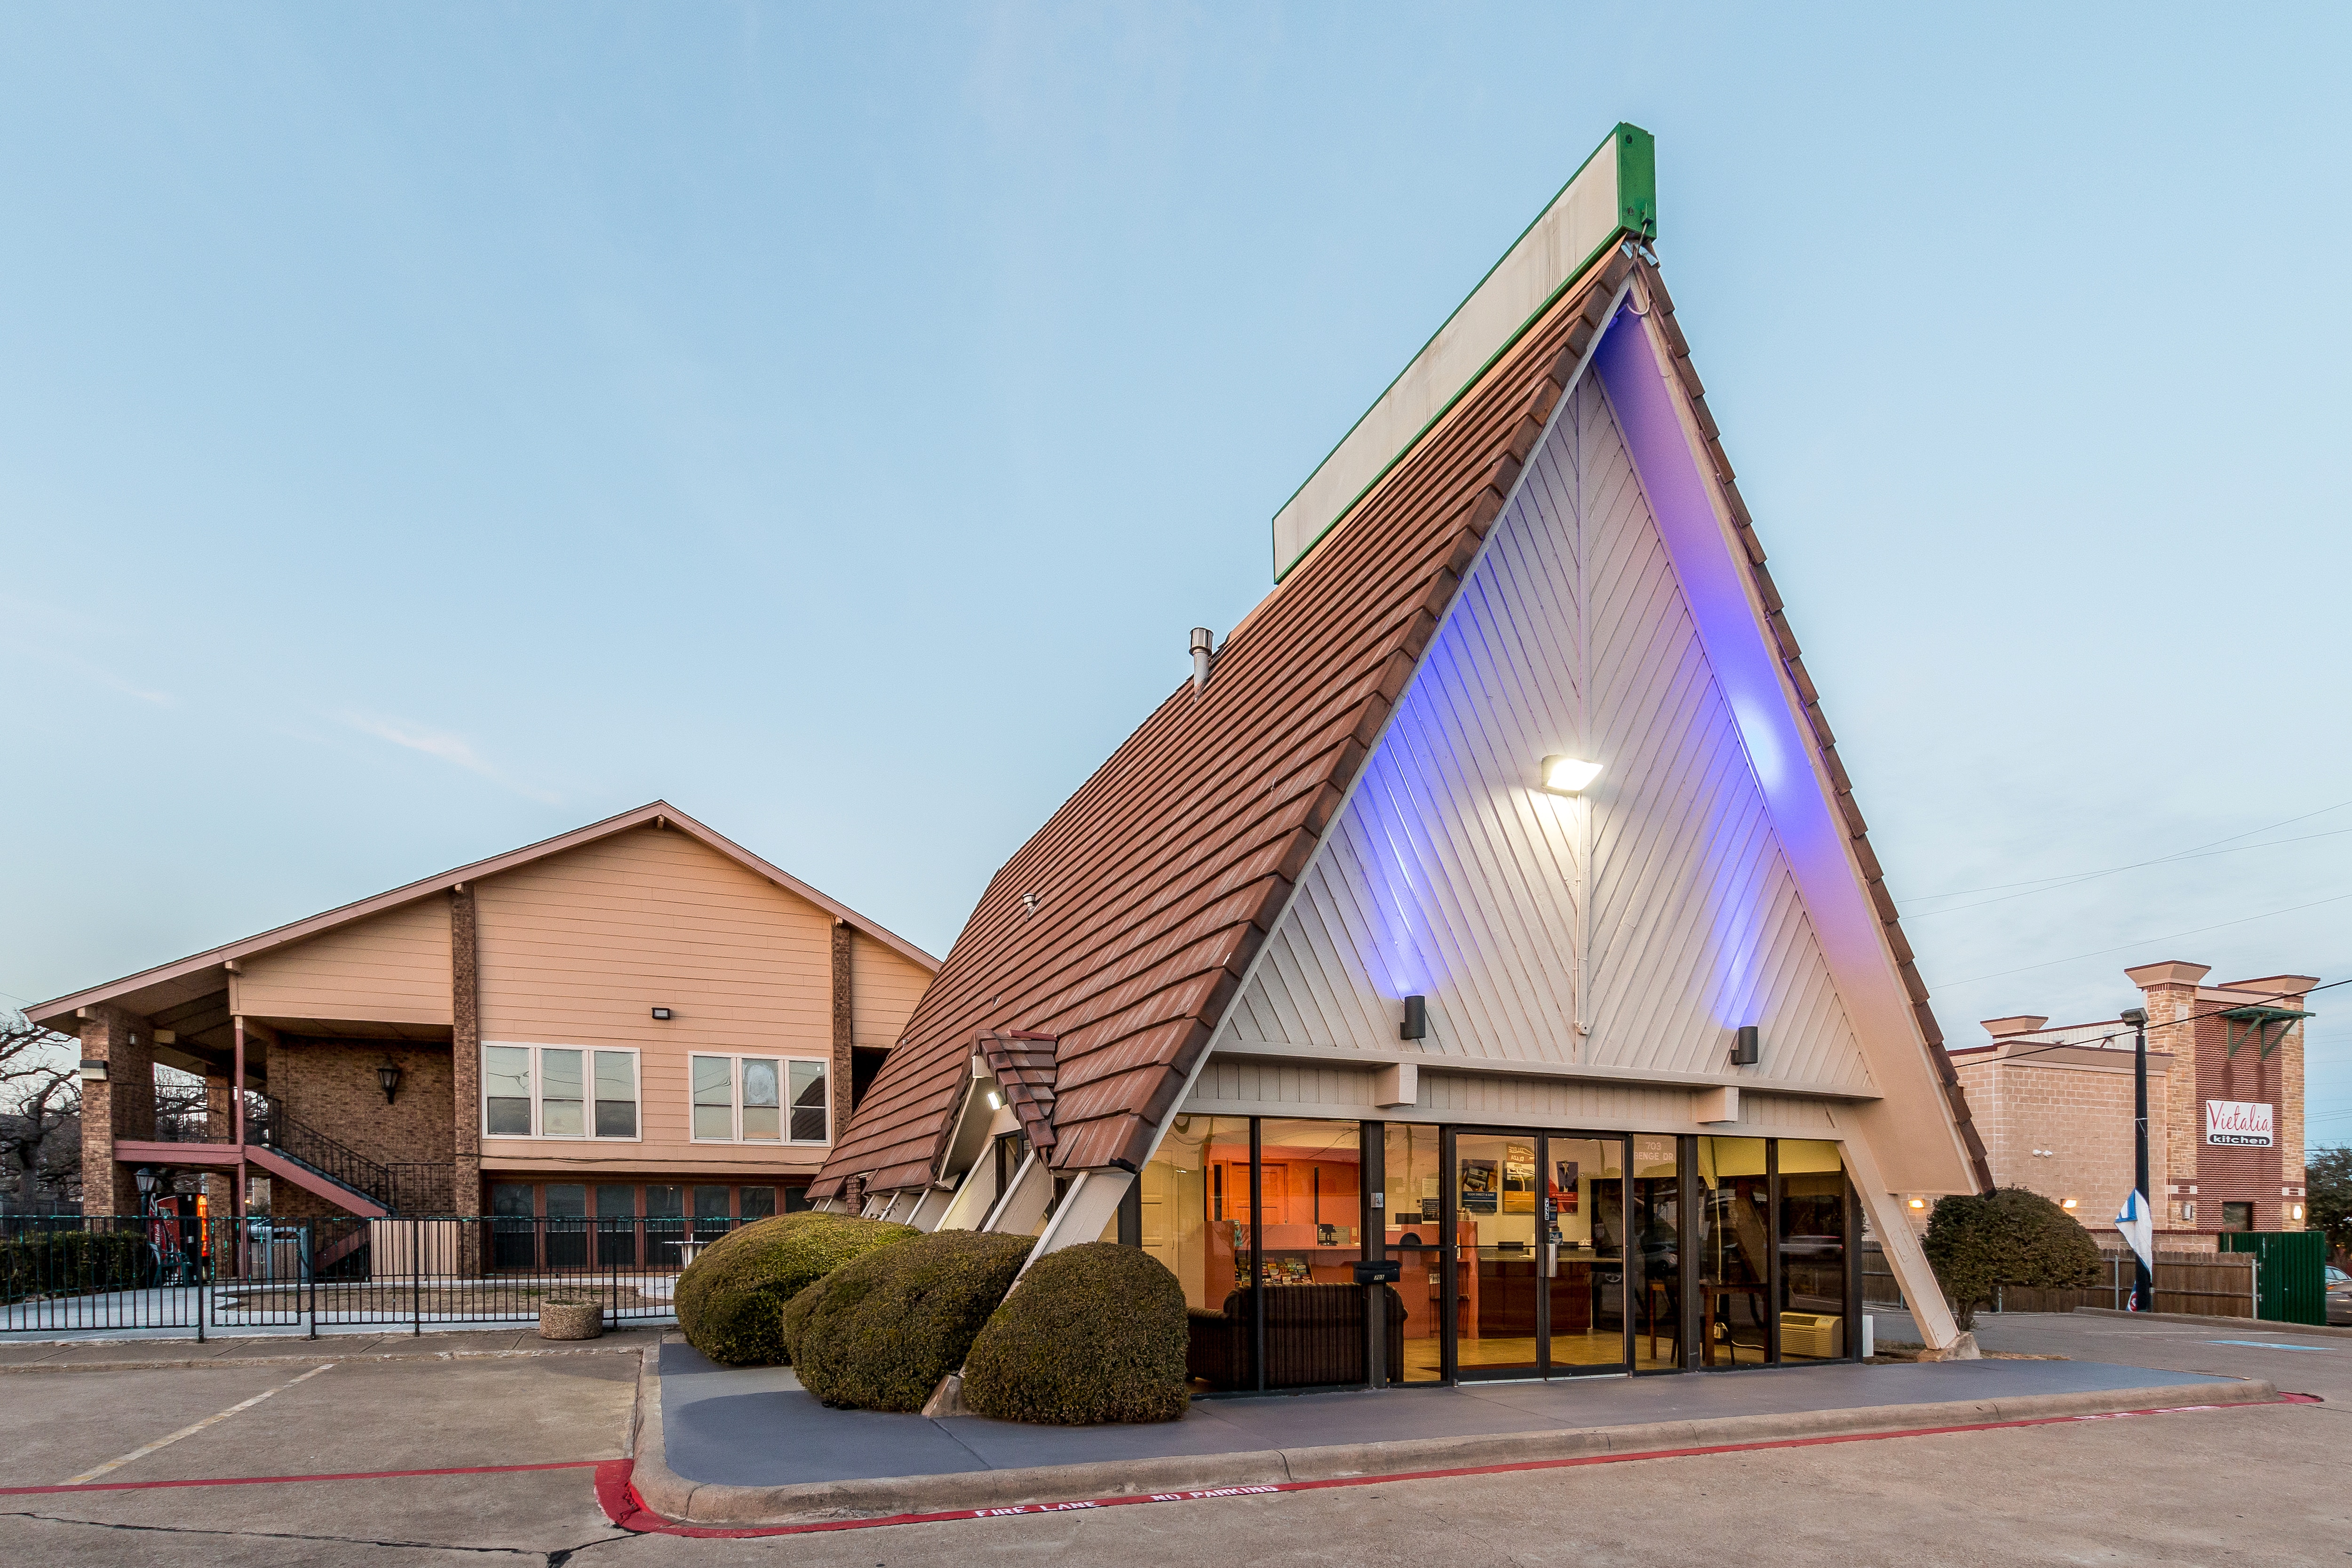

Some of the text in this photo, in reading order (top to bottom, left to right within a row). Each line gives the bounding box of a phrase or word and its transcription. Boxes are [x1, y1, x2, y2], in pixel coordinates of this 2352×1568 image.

[2208, 1102, 2272, 1131] Vietalia
[2214, 1135, 2266, 1144] kitchen
[1646, 1142, 1661, 1150] 703
[1634, 1152, 1659, 1160] BENGE
[1189, 1486, 1279, 1498] PARKING
[974, 1501, 1102, 1517] FIRE LANE
